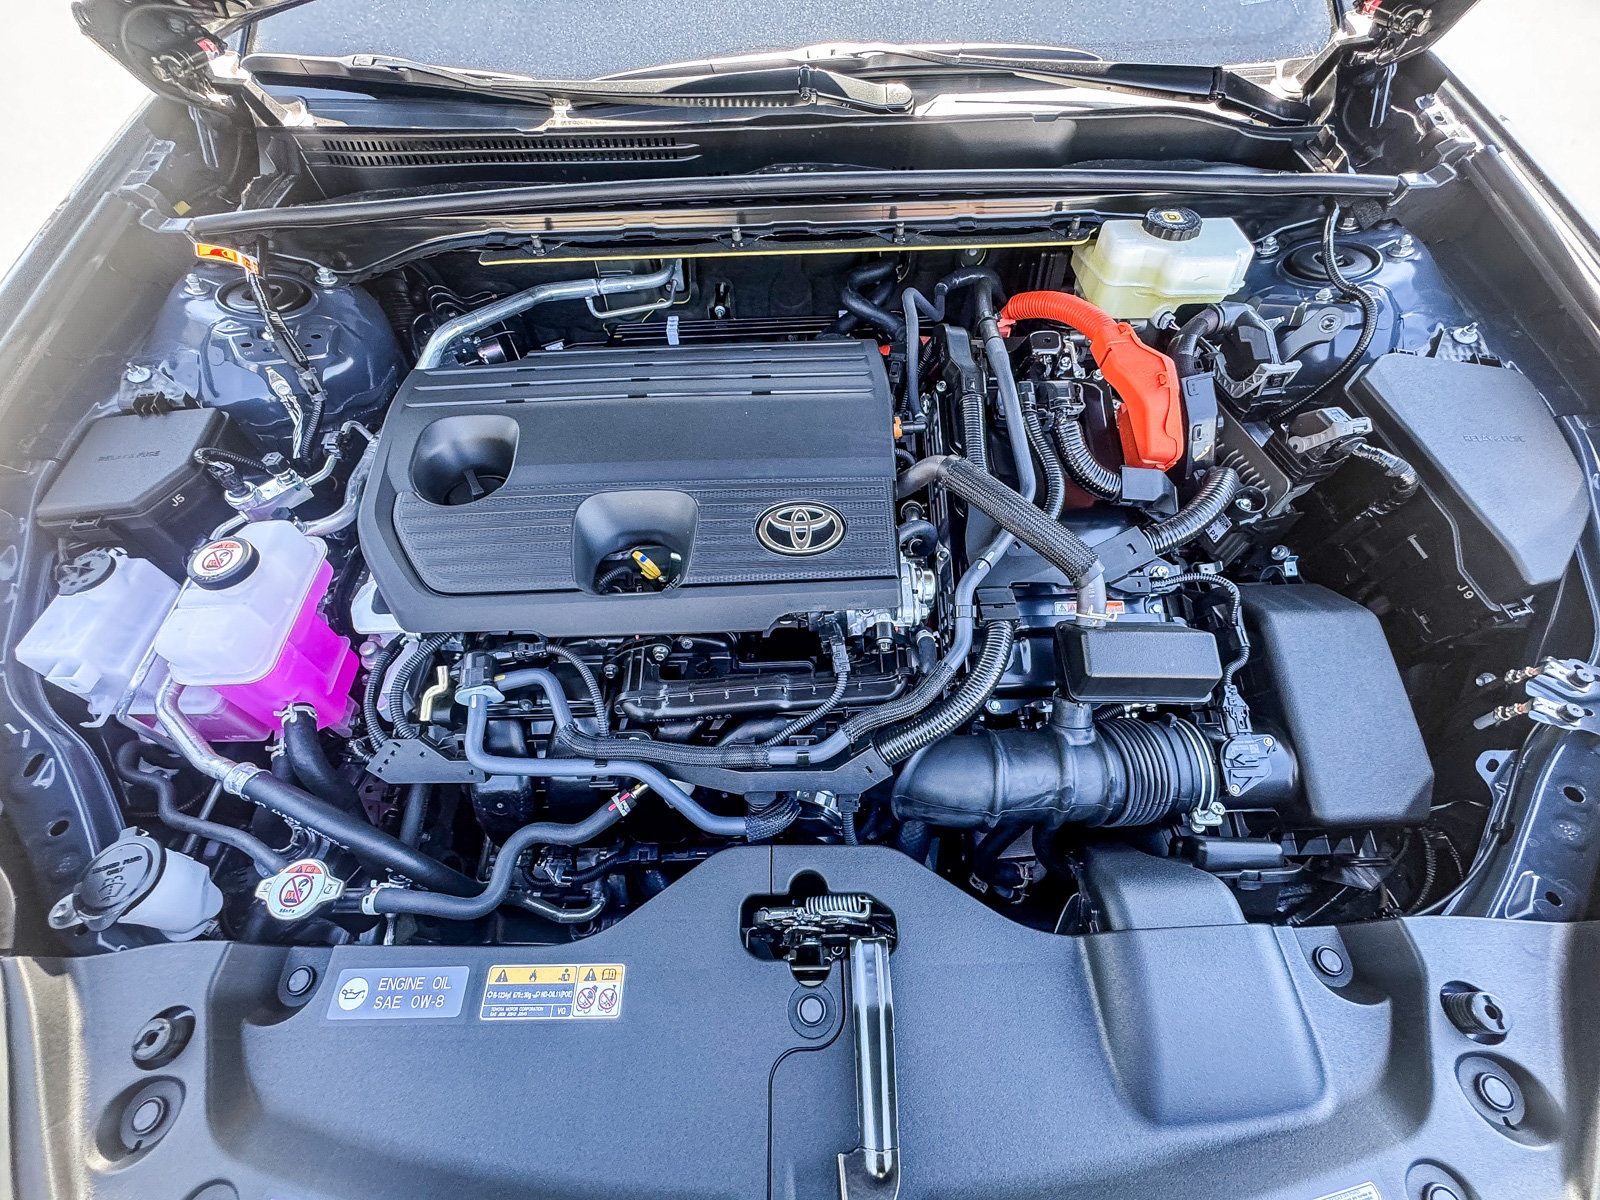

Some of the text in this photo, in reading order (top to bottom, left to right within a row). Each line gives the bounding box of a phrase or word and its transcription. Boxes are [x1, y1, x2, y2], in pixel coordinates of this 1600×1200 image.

[171, 493, 185, 507] J5
[1456, 584, 1475, 600] J9
[377, 976, 452, 991] ENGINE OIL
[373, 994, 445, 1010] SAE 0W-8
